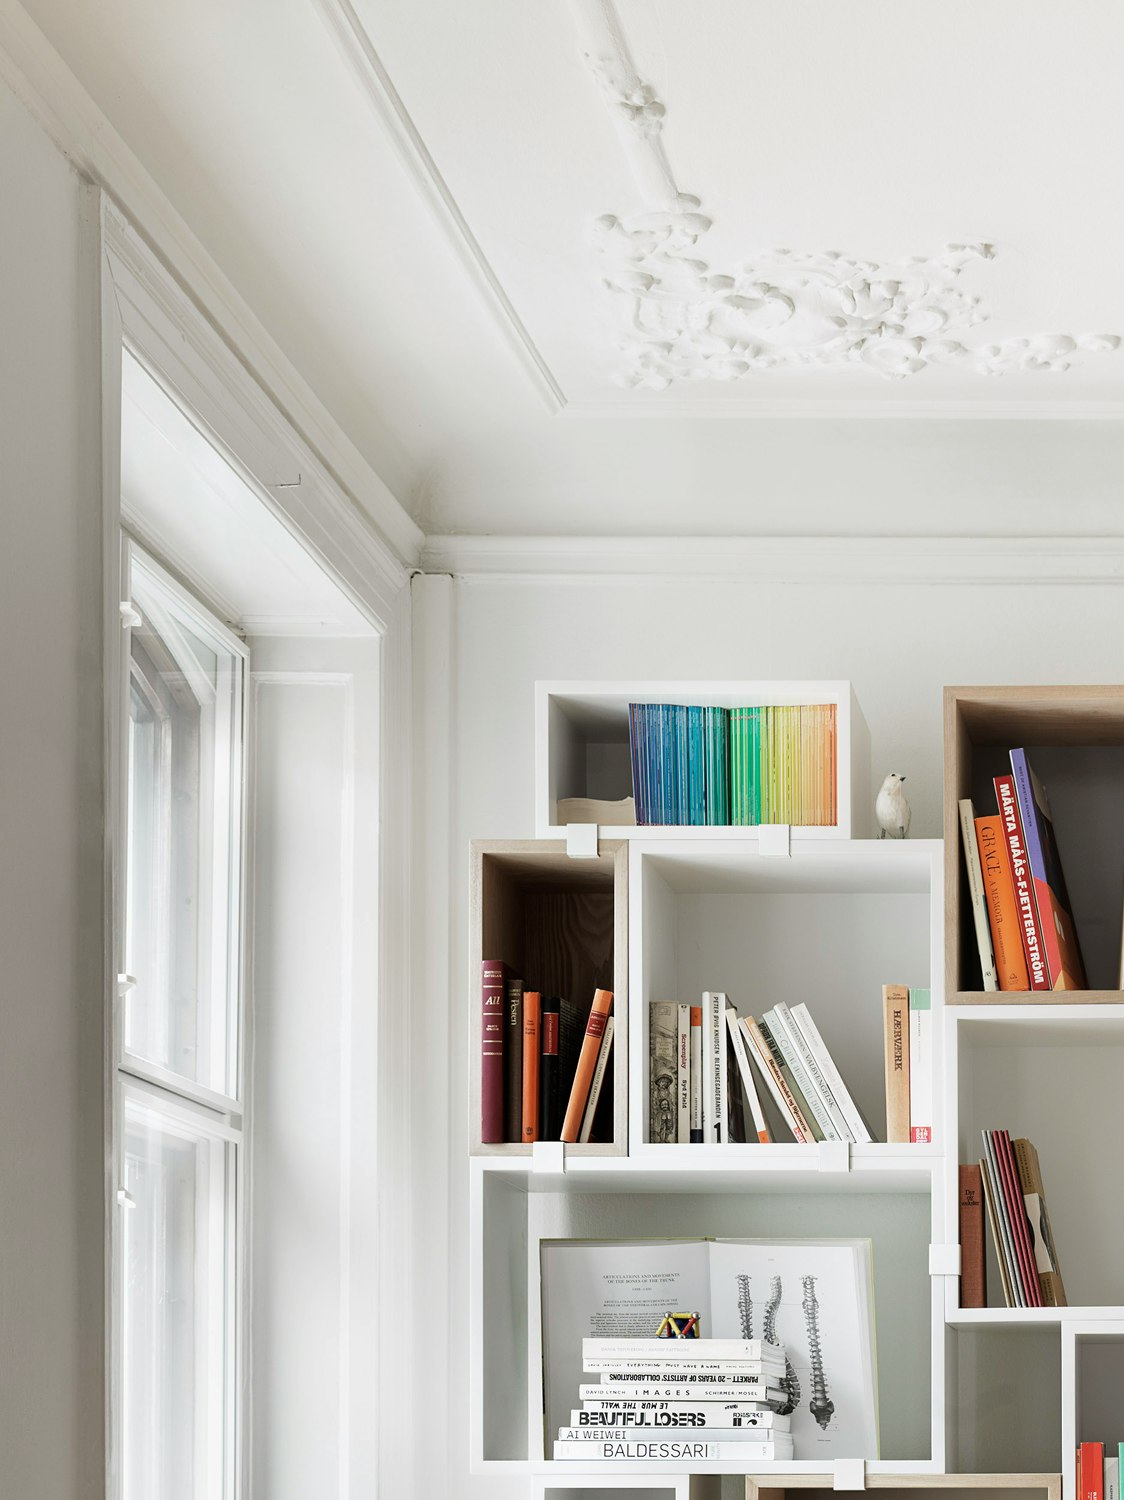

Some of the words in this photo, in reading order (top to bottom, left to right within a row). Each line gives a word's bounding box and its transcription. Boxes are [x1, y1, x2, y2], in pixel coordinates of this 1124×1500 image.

[981, 826, 1002, 875] GRACE
[999, 783, 1017, 833] MÄRTA
[1008, 834, 1044, 984] MÅÅS-FJETTERSTRÖM
[510, 998, 520, 1026] Pesten
[893, 1010, 903, 1071] HÆRVÆRK
[566, 1430, 579, 1439] AI
[582, 1430, 627, 1439] WEIWEI
[603, 1443, 709, 1458] BALDESSARI
